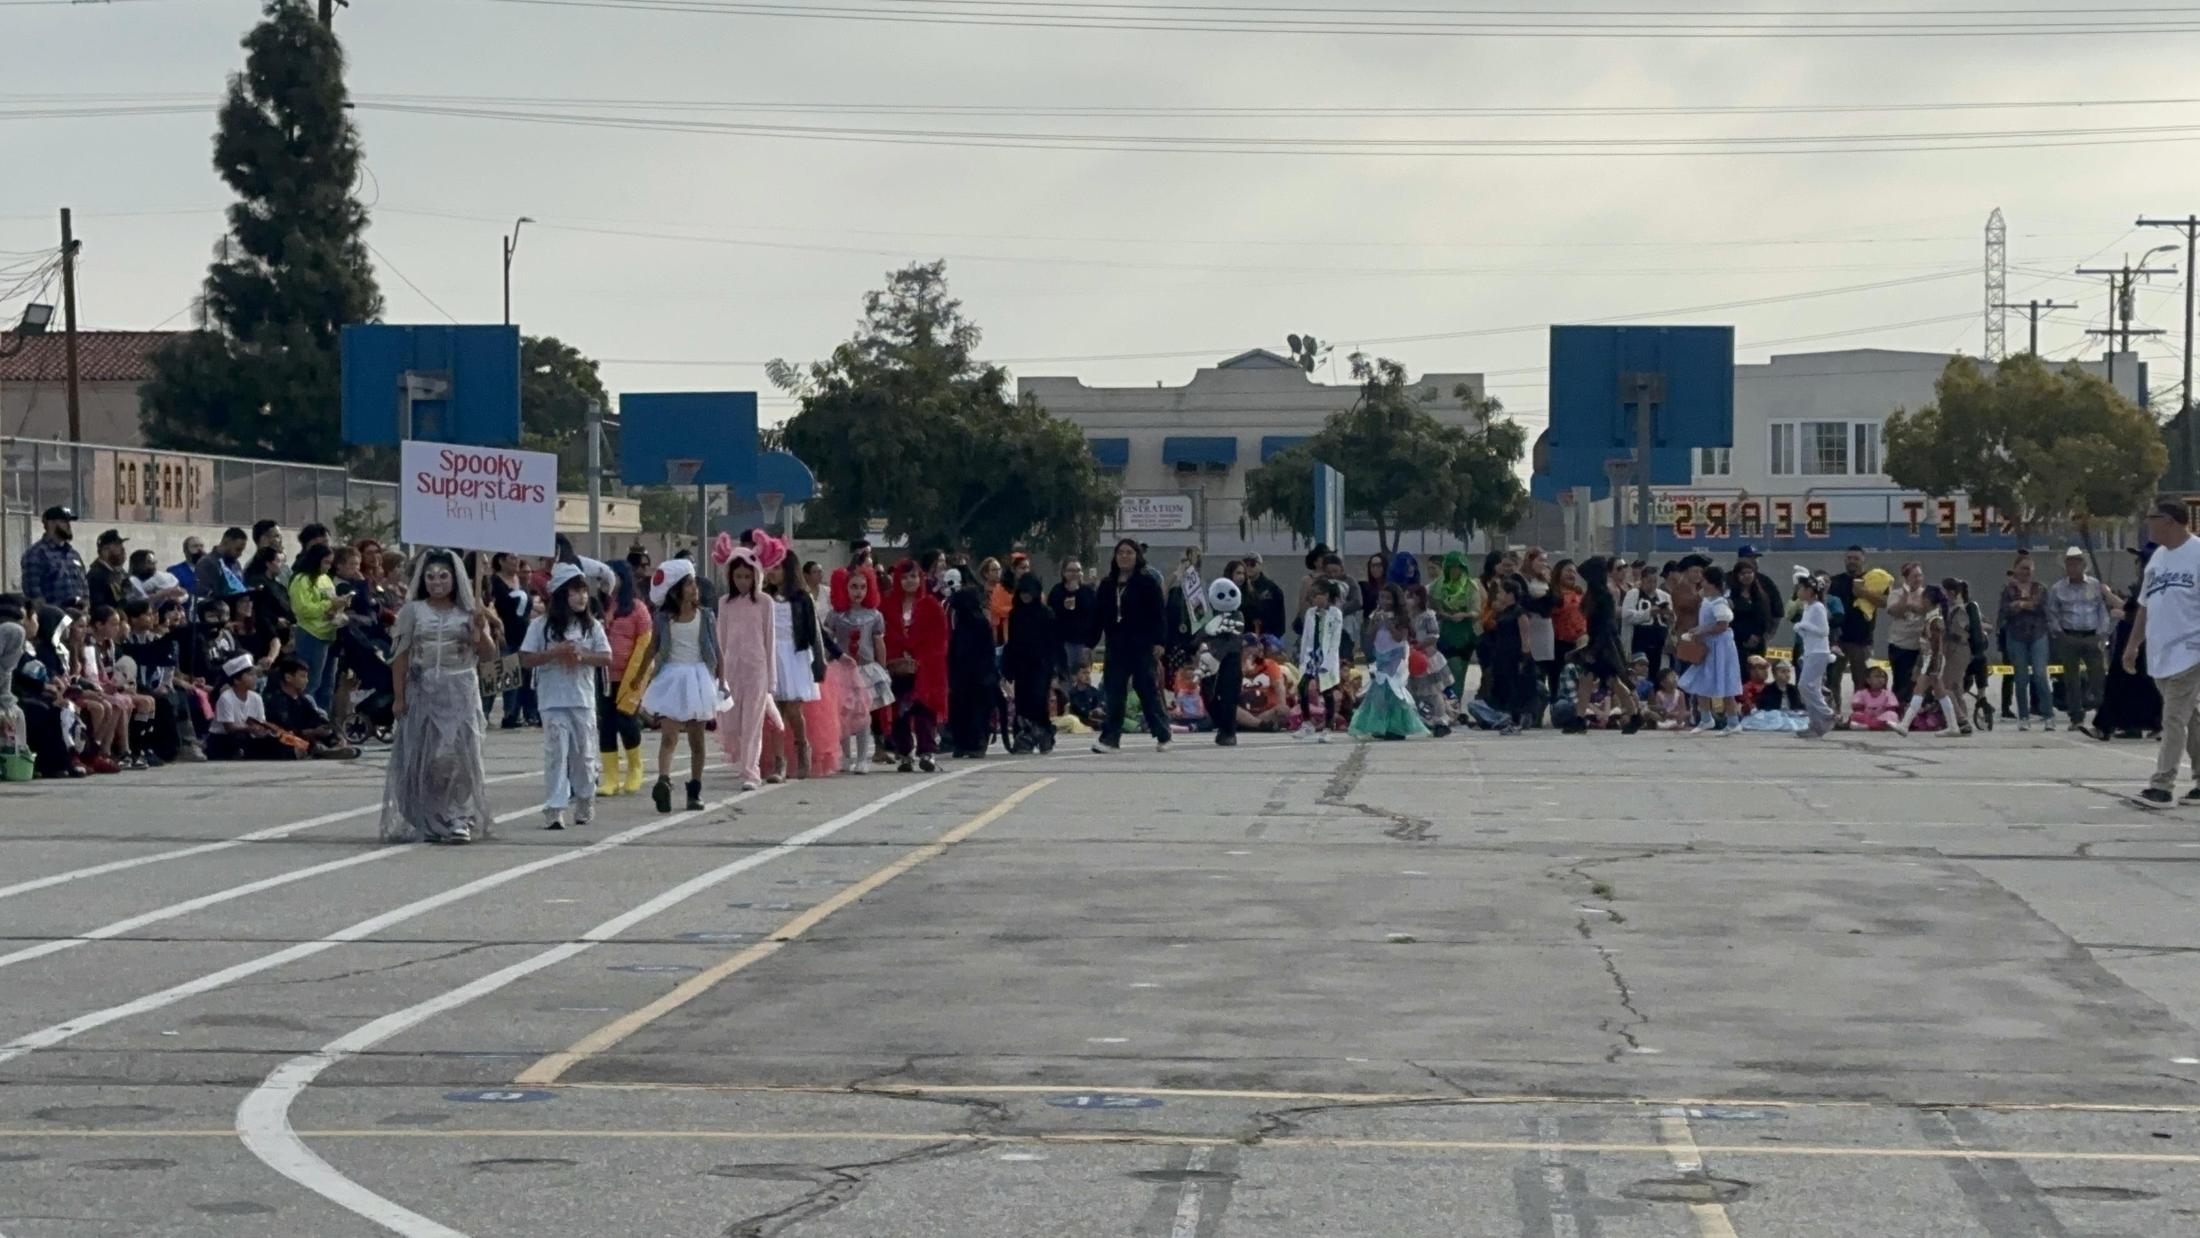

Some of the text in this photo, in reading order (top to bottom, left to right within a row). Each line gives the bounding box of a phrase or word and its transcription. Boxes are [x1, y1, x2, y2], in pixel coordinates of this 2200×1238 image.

[440, 449, 523, 481] Spooky
[417, 472, 545, 503] Superstars
[446, 501, 497, 521] Rm 14
[2146, 568, 2194, 597] Dodgers
